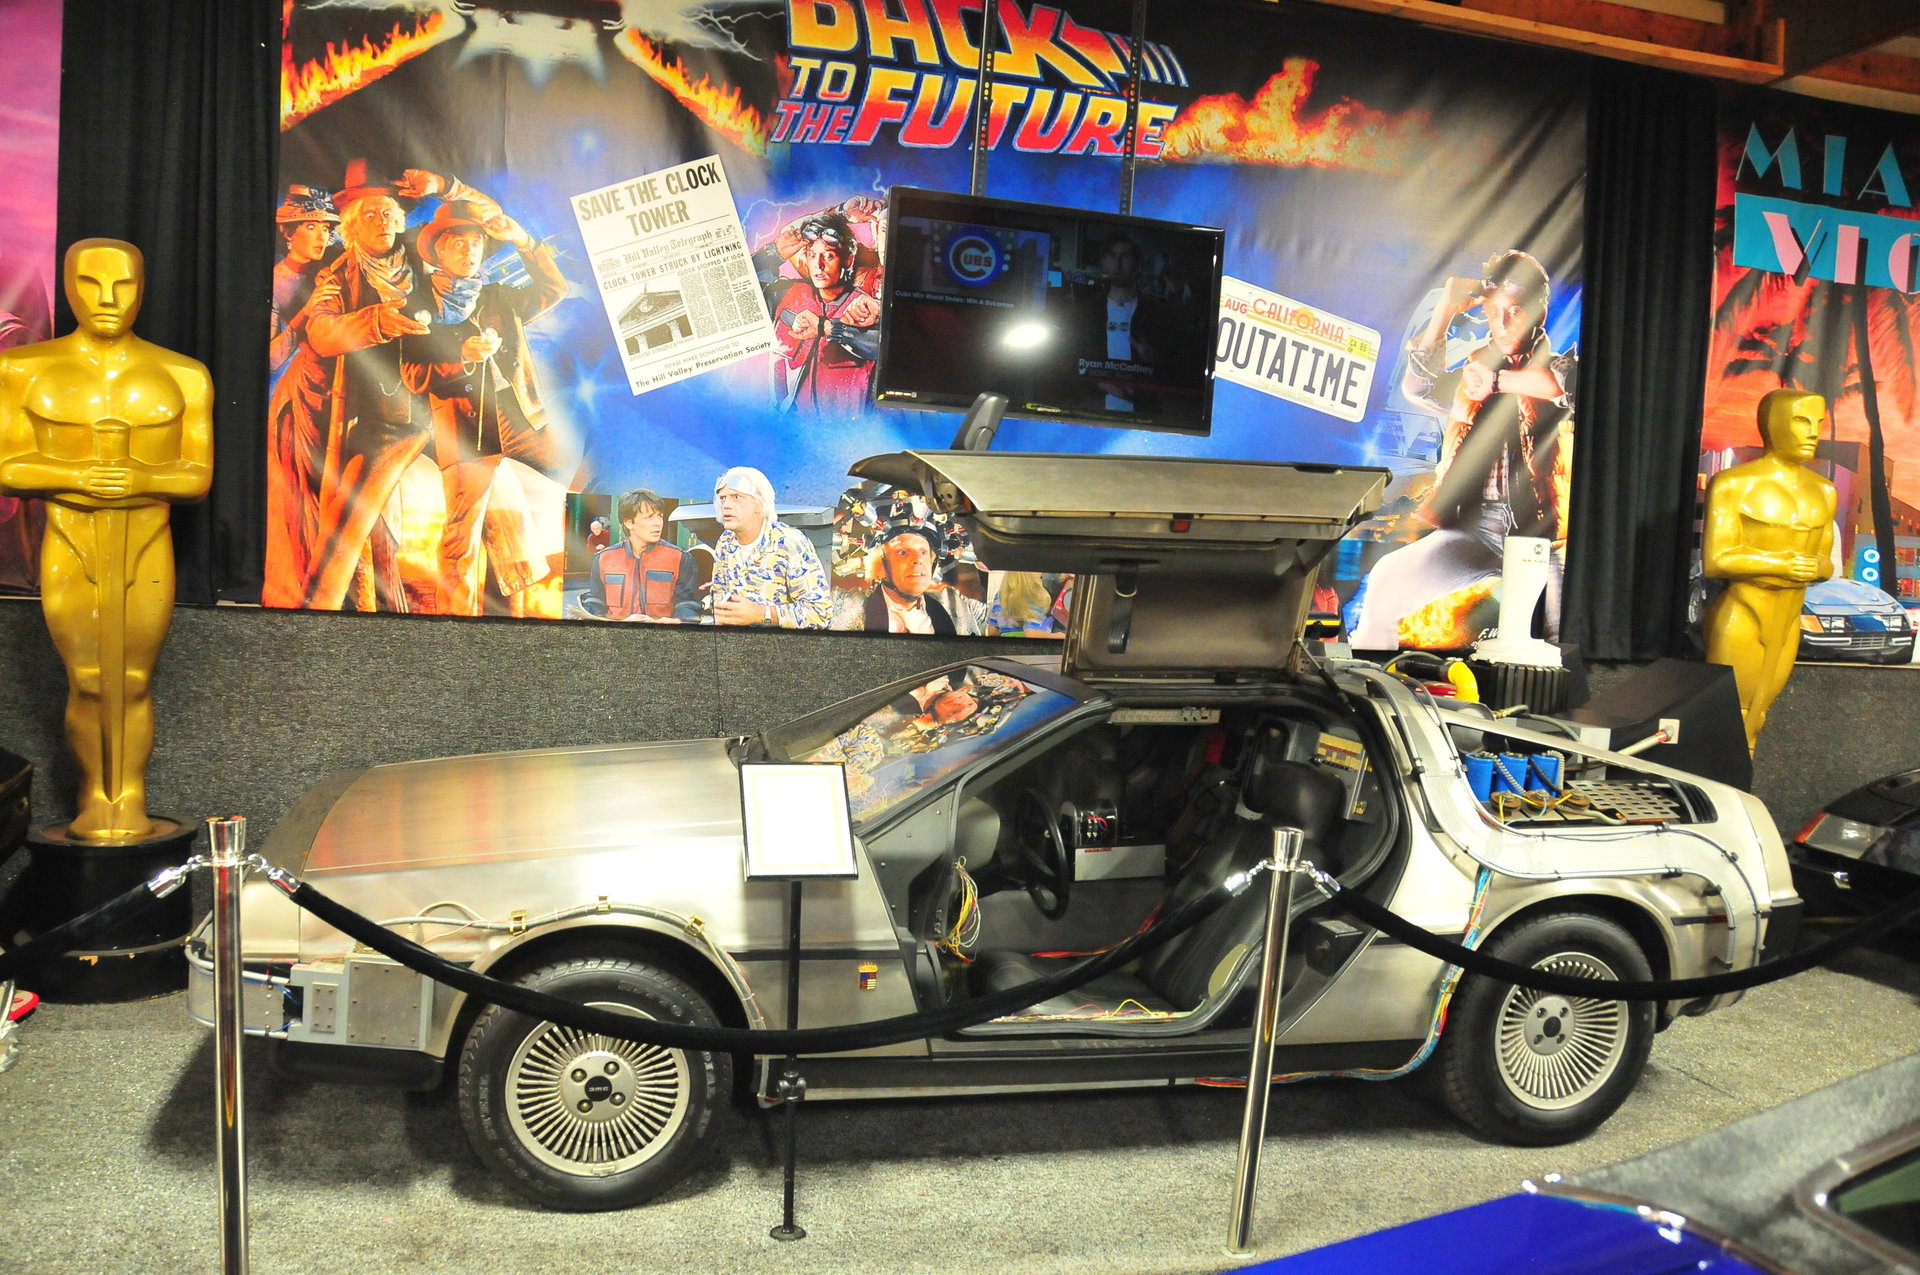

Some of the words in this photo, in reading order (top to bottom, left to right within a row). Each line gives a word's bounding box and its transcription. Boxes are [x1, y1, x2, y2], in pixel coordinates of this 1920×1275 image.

[789, 56, 857, 102] TO
[771, 99, 855, 144] THE
[847, 64, 1178, 160] FUTURE
[577, 189, 624, 221] SAVE
[625, 178, 662, 206] THE
[665, 162, 721, 195] CLOCK
[626, 200, 690, 236] TOWER
[603, 276, 628, 290] CLOCK
[631, 266, 657, 282] TOWER
[659, 256, 689, 273] STRUCK
[690, 252, 701, 263] BY
[703, 241, 742, 259] LIGHTNING
[622, 252, 641, 264] Hill
[670, 230, 712, 250] Telegraph
[1224, 297, 1248, 315] AUG
[1253, 298, 1345, 344] CALIFORNIA
[635, 380, 650, 389] The
[652, 374, 666, 383] Hill
[668, 366, 693, 377] Valley
[695, 350, 744, 369] Preservation
[745, 341, 771, 354] Society
[1078, 357, 1103, 370] Ryan
[1216, 316, 1367, 409] OUTATIME
